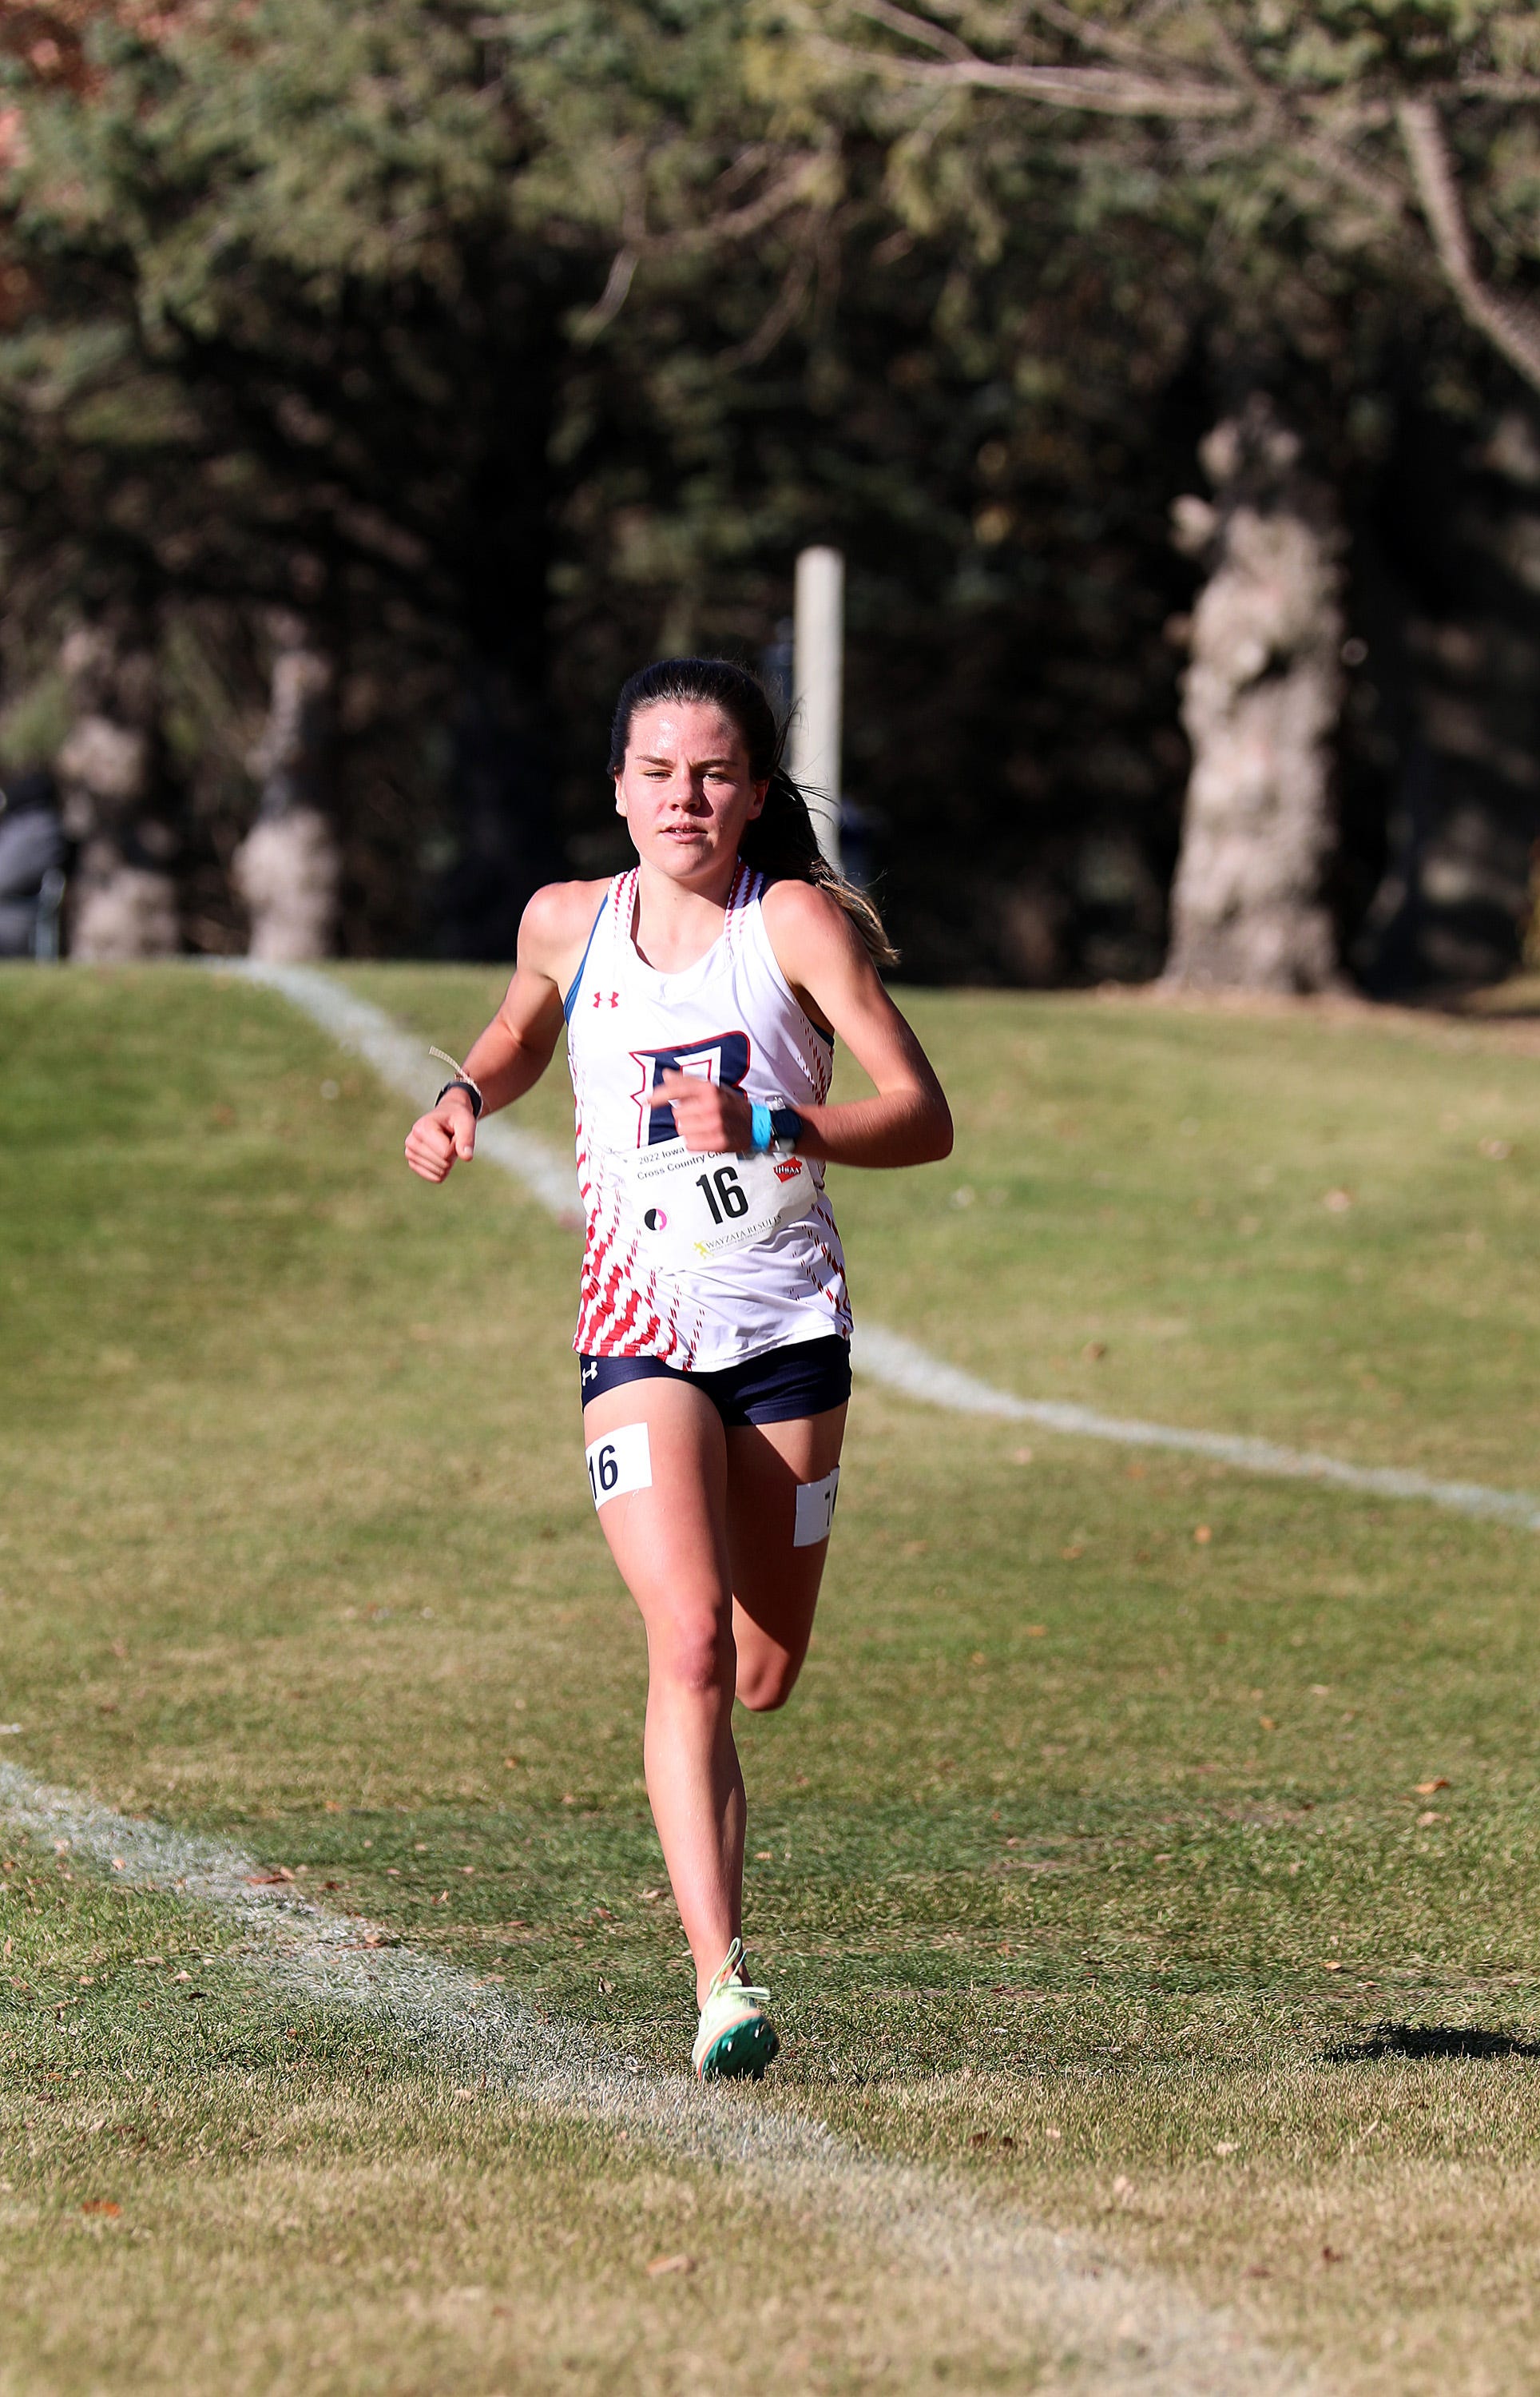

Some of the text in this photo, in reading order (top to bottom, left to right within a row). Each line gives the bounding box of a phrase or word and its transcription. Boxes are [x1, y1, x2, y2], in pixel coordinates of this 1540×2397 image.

[637, 1168, 665, 1180] Cross
[667, 1155, 705, 1171] Country
[639, 1147, 685, 1165] 2022 Iowa
[696, 1167, 748, 1224] 16
[705, 1230, 746, 1249] WAYZATA
[747, 1215, 782, 1234] RESULTS
[589, 1445, 618, 1500] 16
[824, 1482, 839, 1527] 1
